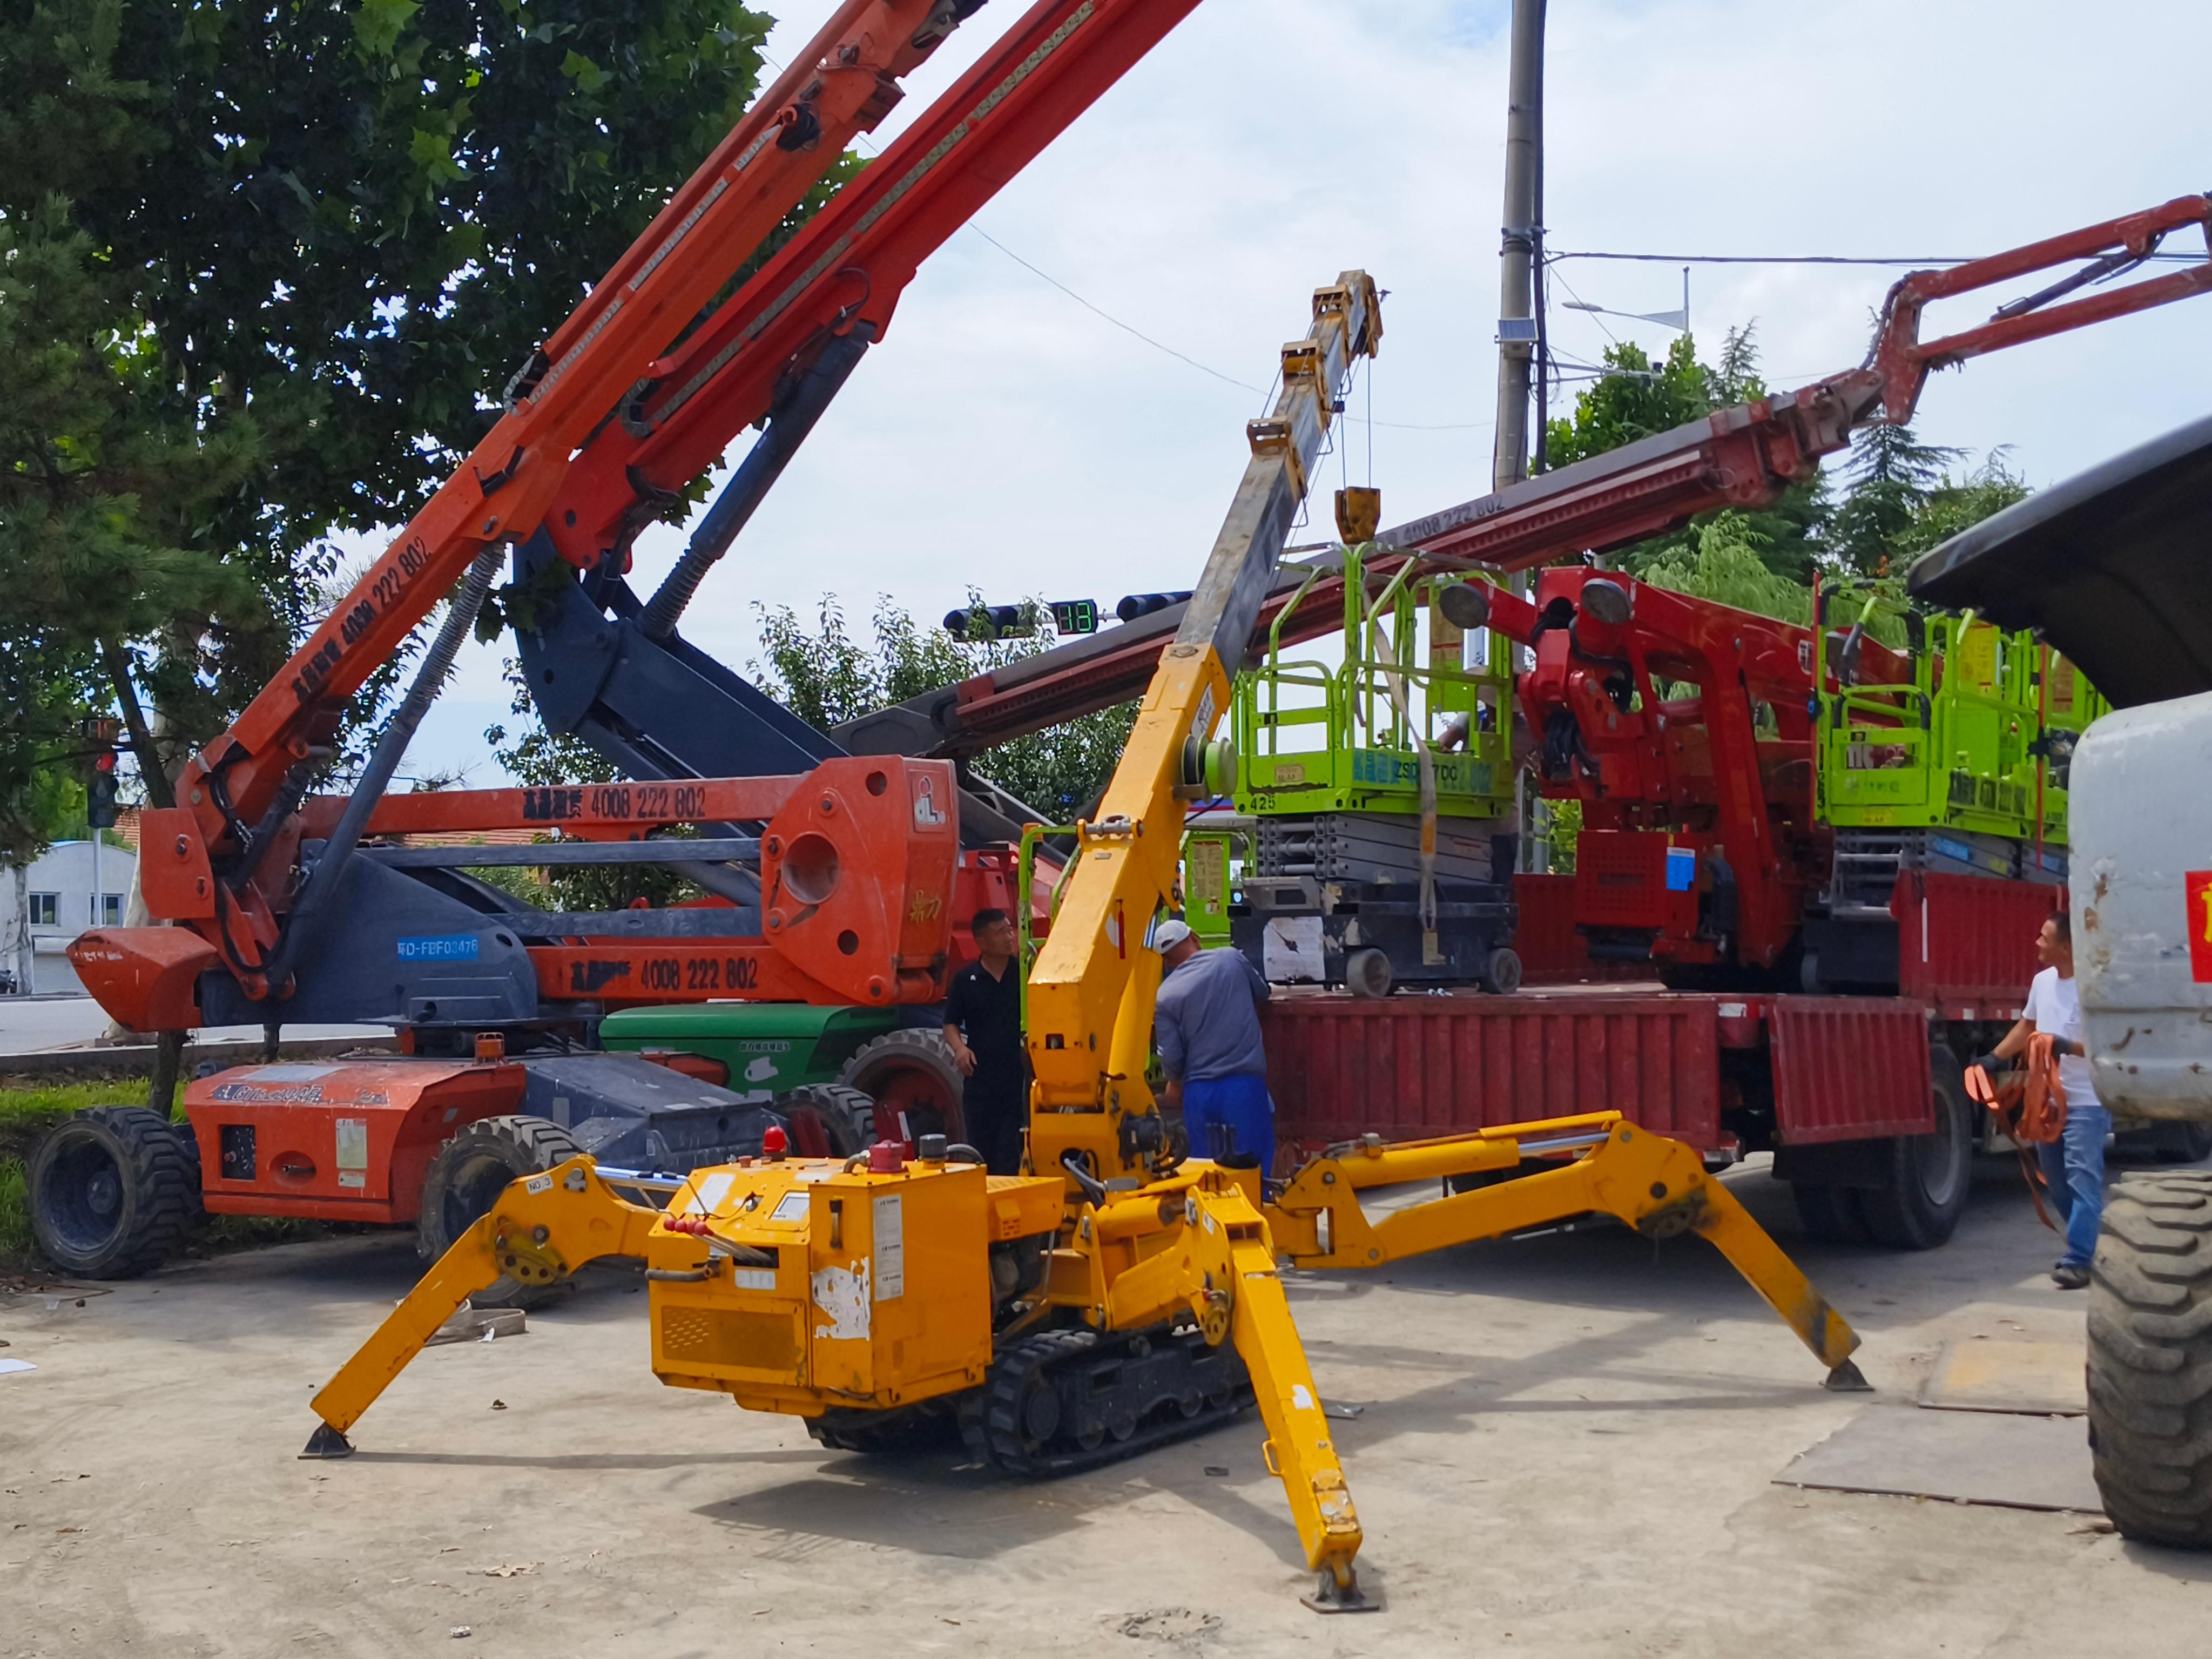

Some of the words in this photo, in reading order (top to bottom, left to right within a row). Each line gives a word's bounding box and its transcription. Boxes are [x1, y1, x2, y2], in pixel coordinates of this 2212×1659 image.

[372, 567, 403, 609] 222
[398, 536, 433, 578] 802
[1067, 602, 1091, 632] 13
[591, 787, 630, 819] 4008
[637, 786, 669, 819] 222
[675, 786, 706, 818] 802
[641, 958, 681, 991] 4008
[687, 958, 719, 990] 222
[726, 956, 758, 990] 802
